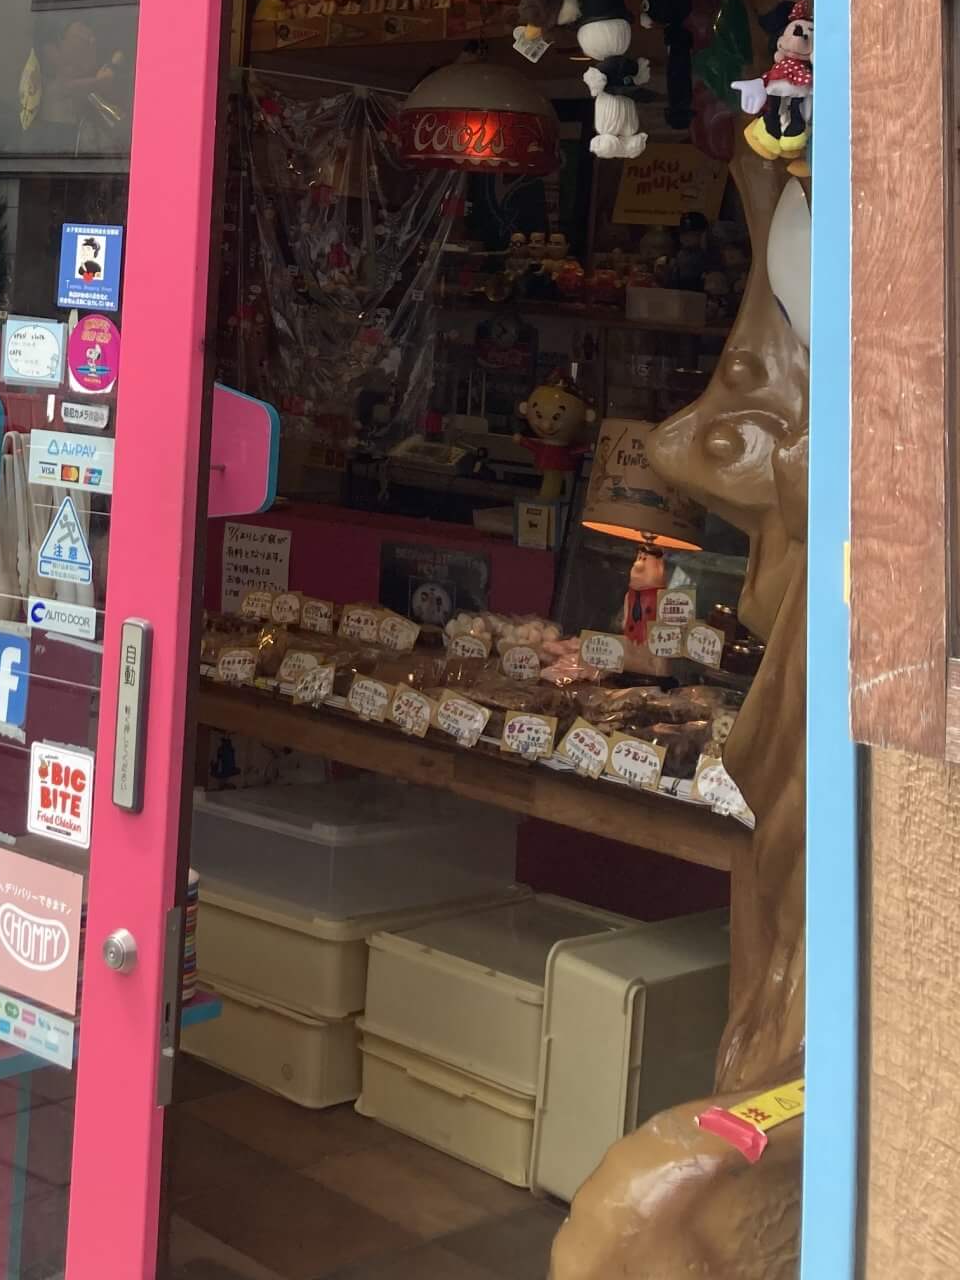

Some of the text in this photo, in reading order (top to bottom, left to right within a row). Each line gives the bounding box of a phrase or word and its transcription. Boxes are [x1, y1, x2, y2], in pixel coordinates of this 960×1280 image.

[61, 441, 97, 458] AirPAY
[41, 465, 56, 475] VISA
[53, 543, 79, 560] 注意
[45, 609, 90, 628] AUTO DOOR
[124, 644, 137, 686] 自動
[51, 761, 87, 793] BIG
[40, 785, 82, 819] BITE
[36, 810, 82, 833] Fried Chicken
[3, 911, 61, 963] CHOMPY
